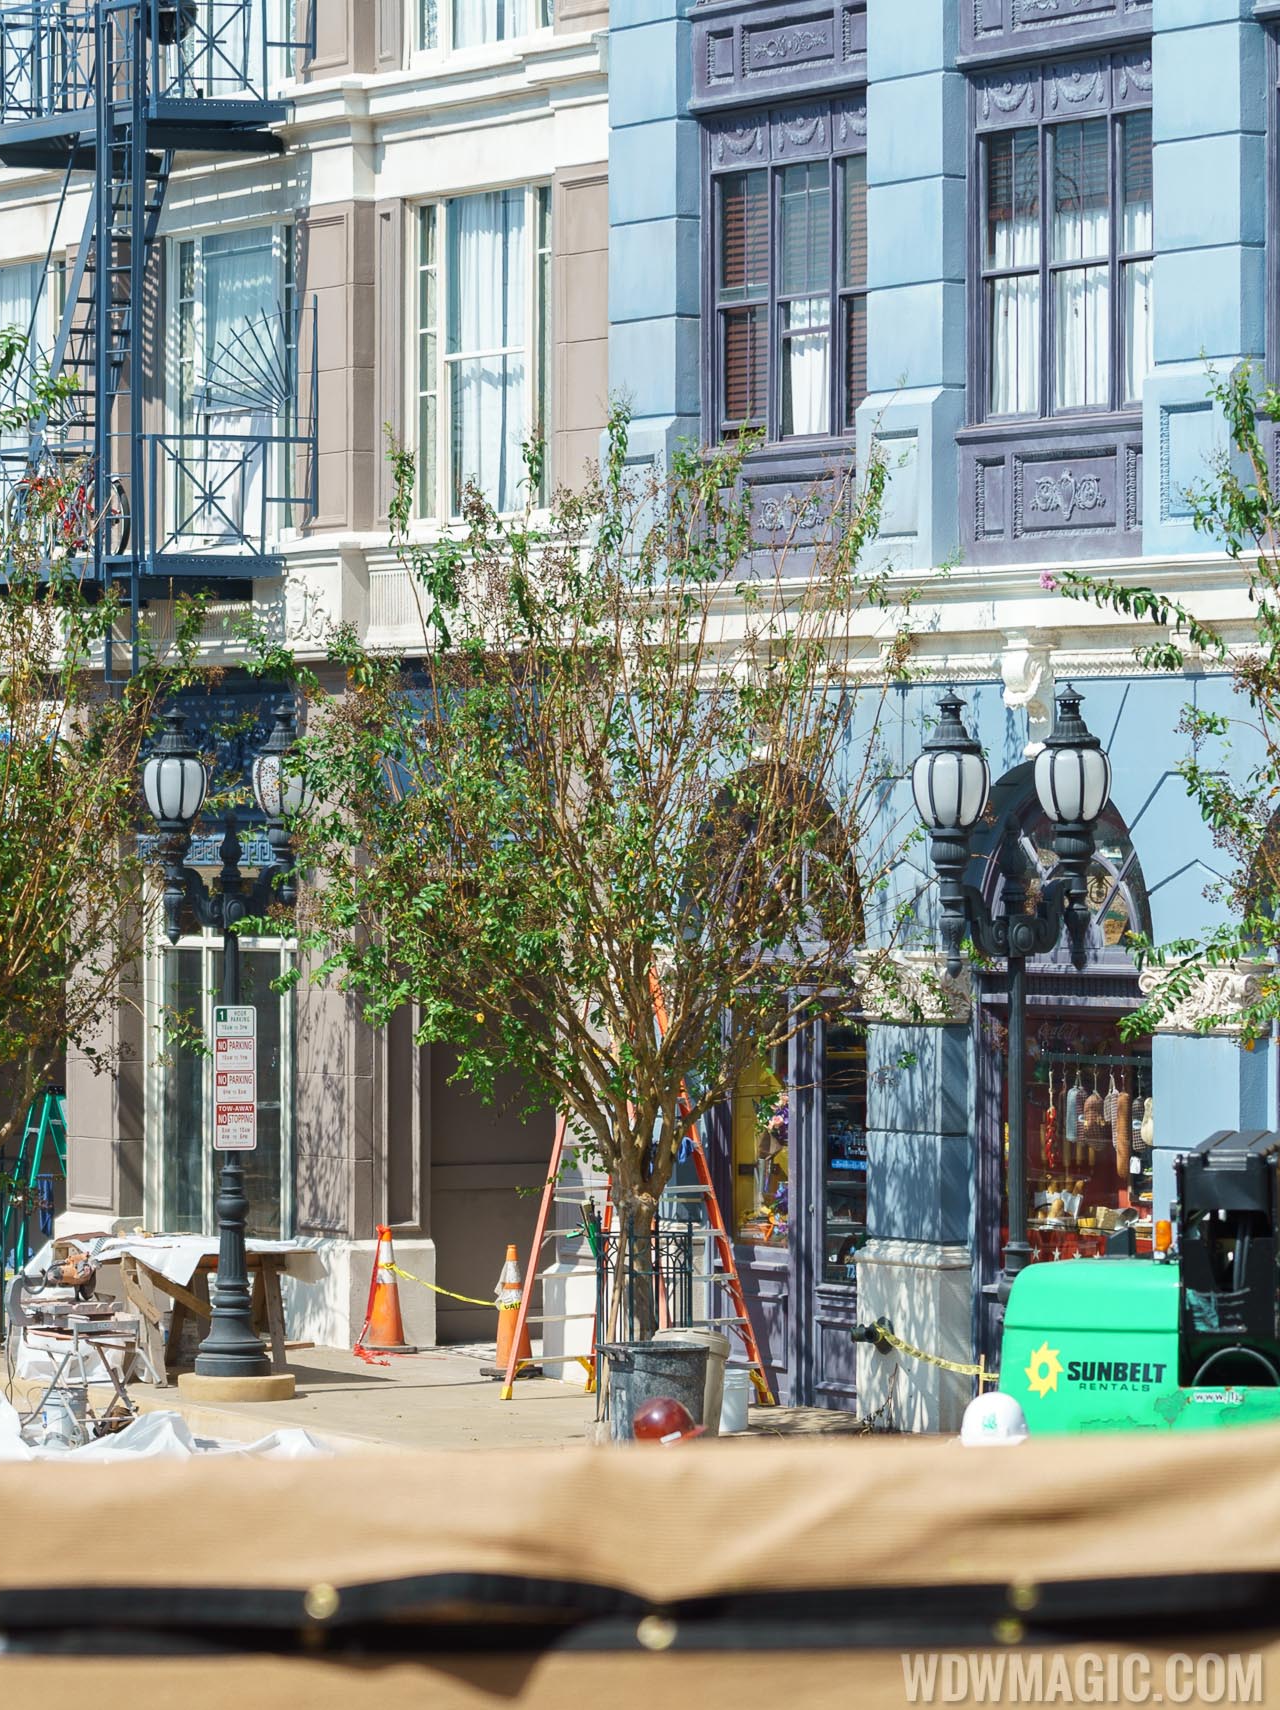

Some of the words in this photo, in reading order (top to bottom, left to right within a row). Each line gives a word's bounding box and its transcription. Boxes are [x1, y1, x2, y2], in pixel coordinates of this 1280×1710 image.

[219, 1010, 225, 1021] 1
[218, 1040, 227, 1050] NO
[229, 1041, 253, 1050] PARKING
[218, 1074, 227, 1085] NO
[229, 1075, 253, 1085] PARKING
[218, 1113, 227, 1124] NO
[229, 1114, 253, 1124] STOPPING
[1067, 1361, 1167, 1383] SUNBELT
[1079, 1383, 1151, 1392] RENTALS
